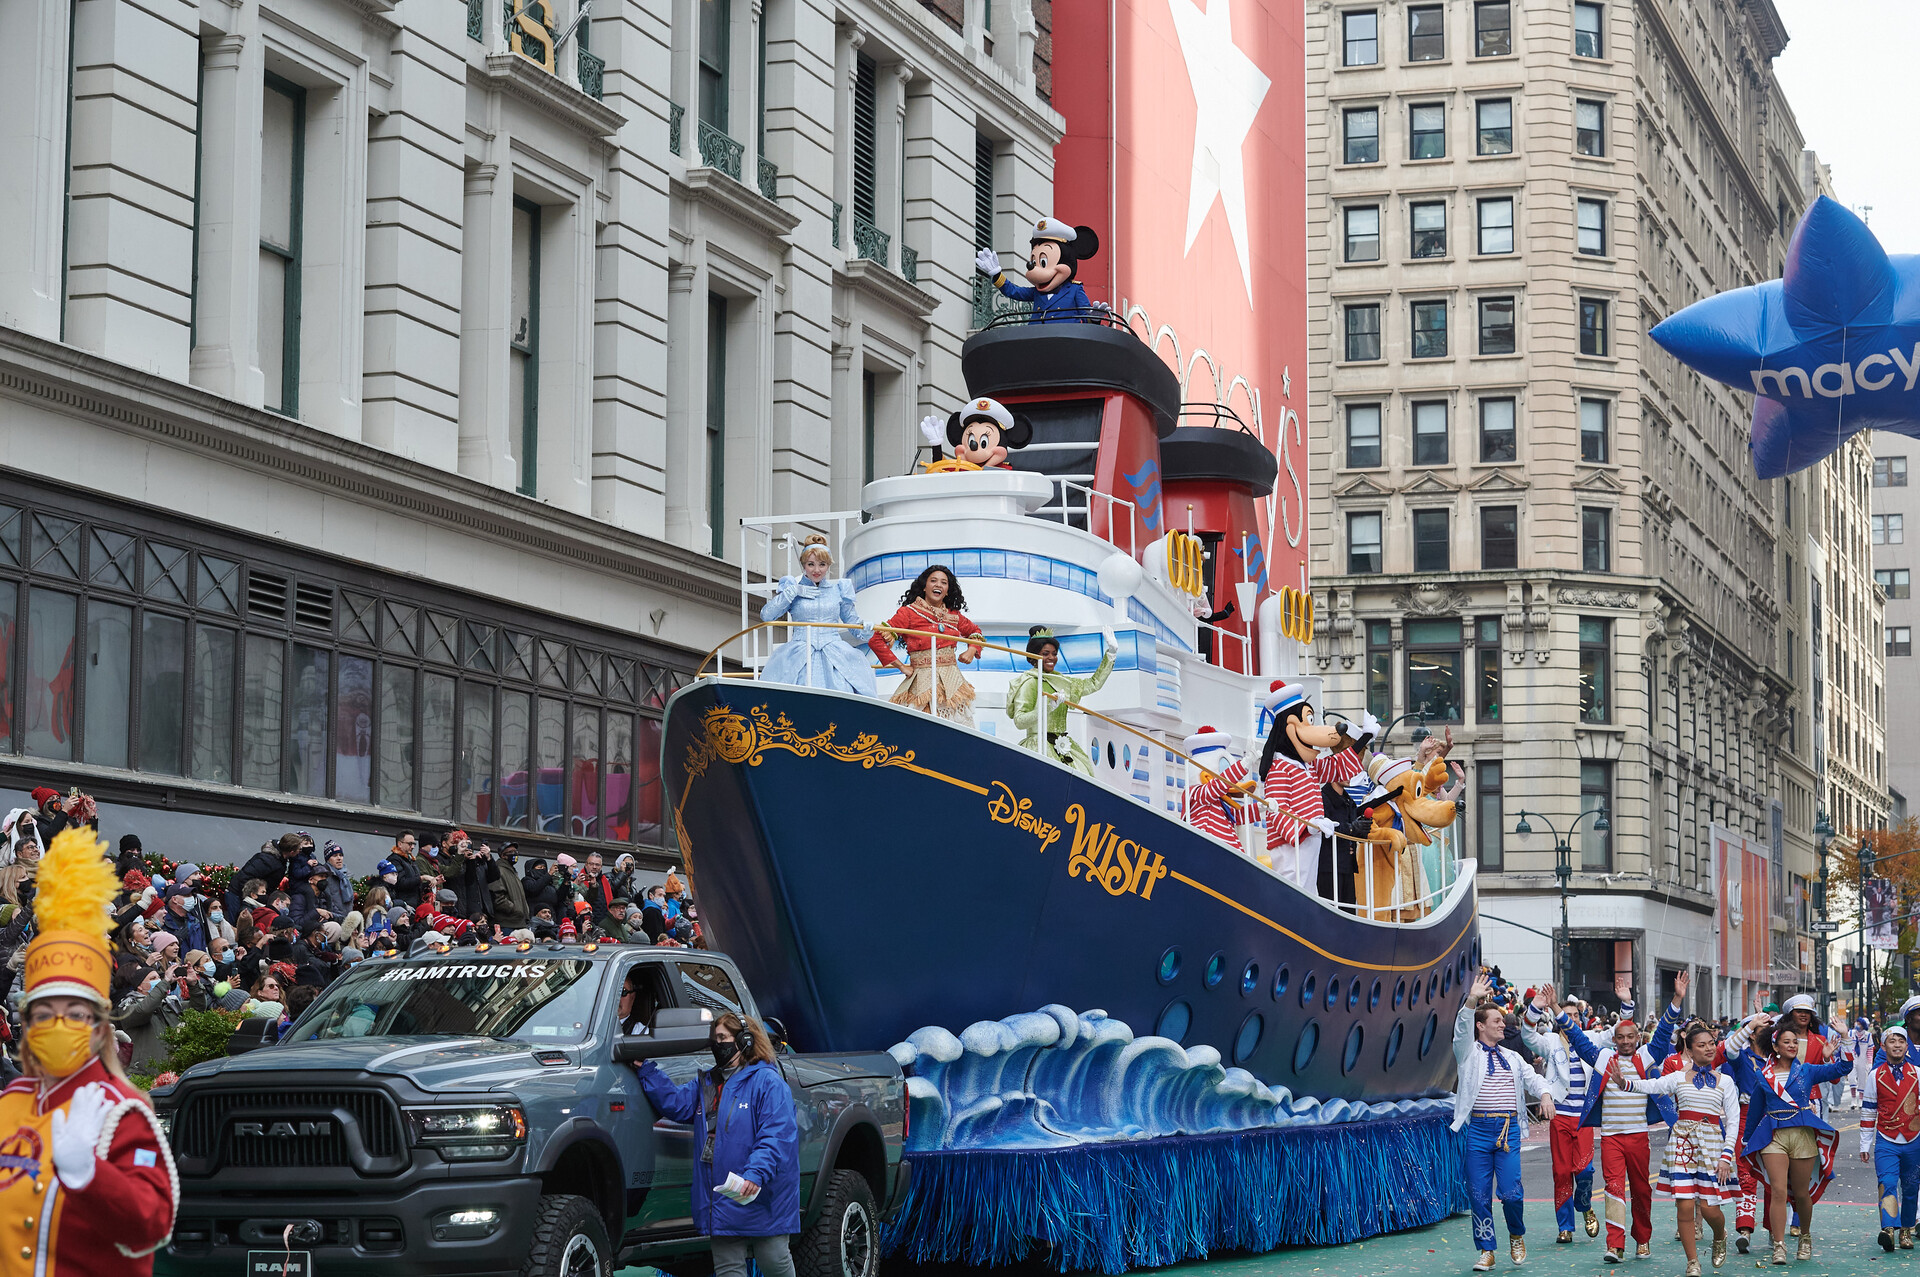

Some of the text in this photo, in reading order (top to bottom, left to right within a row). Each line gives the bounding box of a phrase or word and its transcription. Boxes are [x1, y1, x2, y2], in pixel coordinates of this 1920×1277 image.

[28, 951, 94, 977] MACY'S
[378, 964, 546, 983] #RAMTRUCKS
[234, 1121, 331, 1136] RAM
[255, 1263, 301, 1272] RAM
